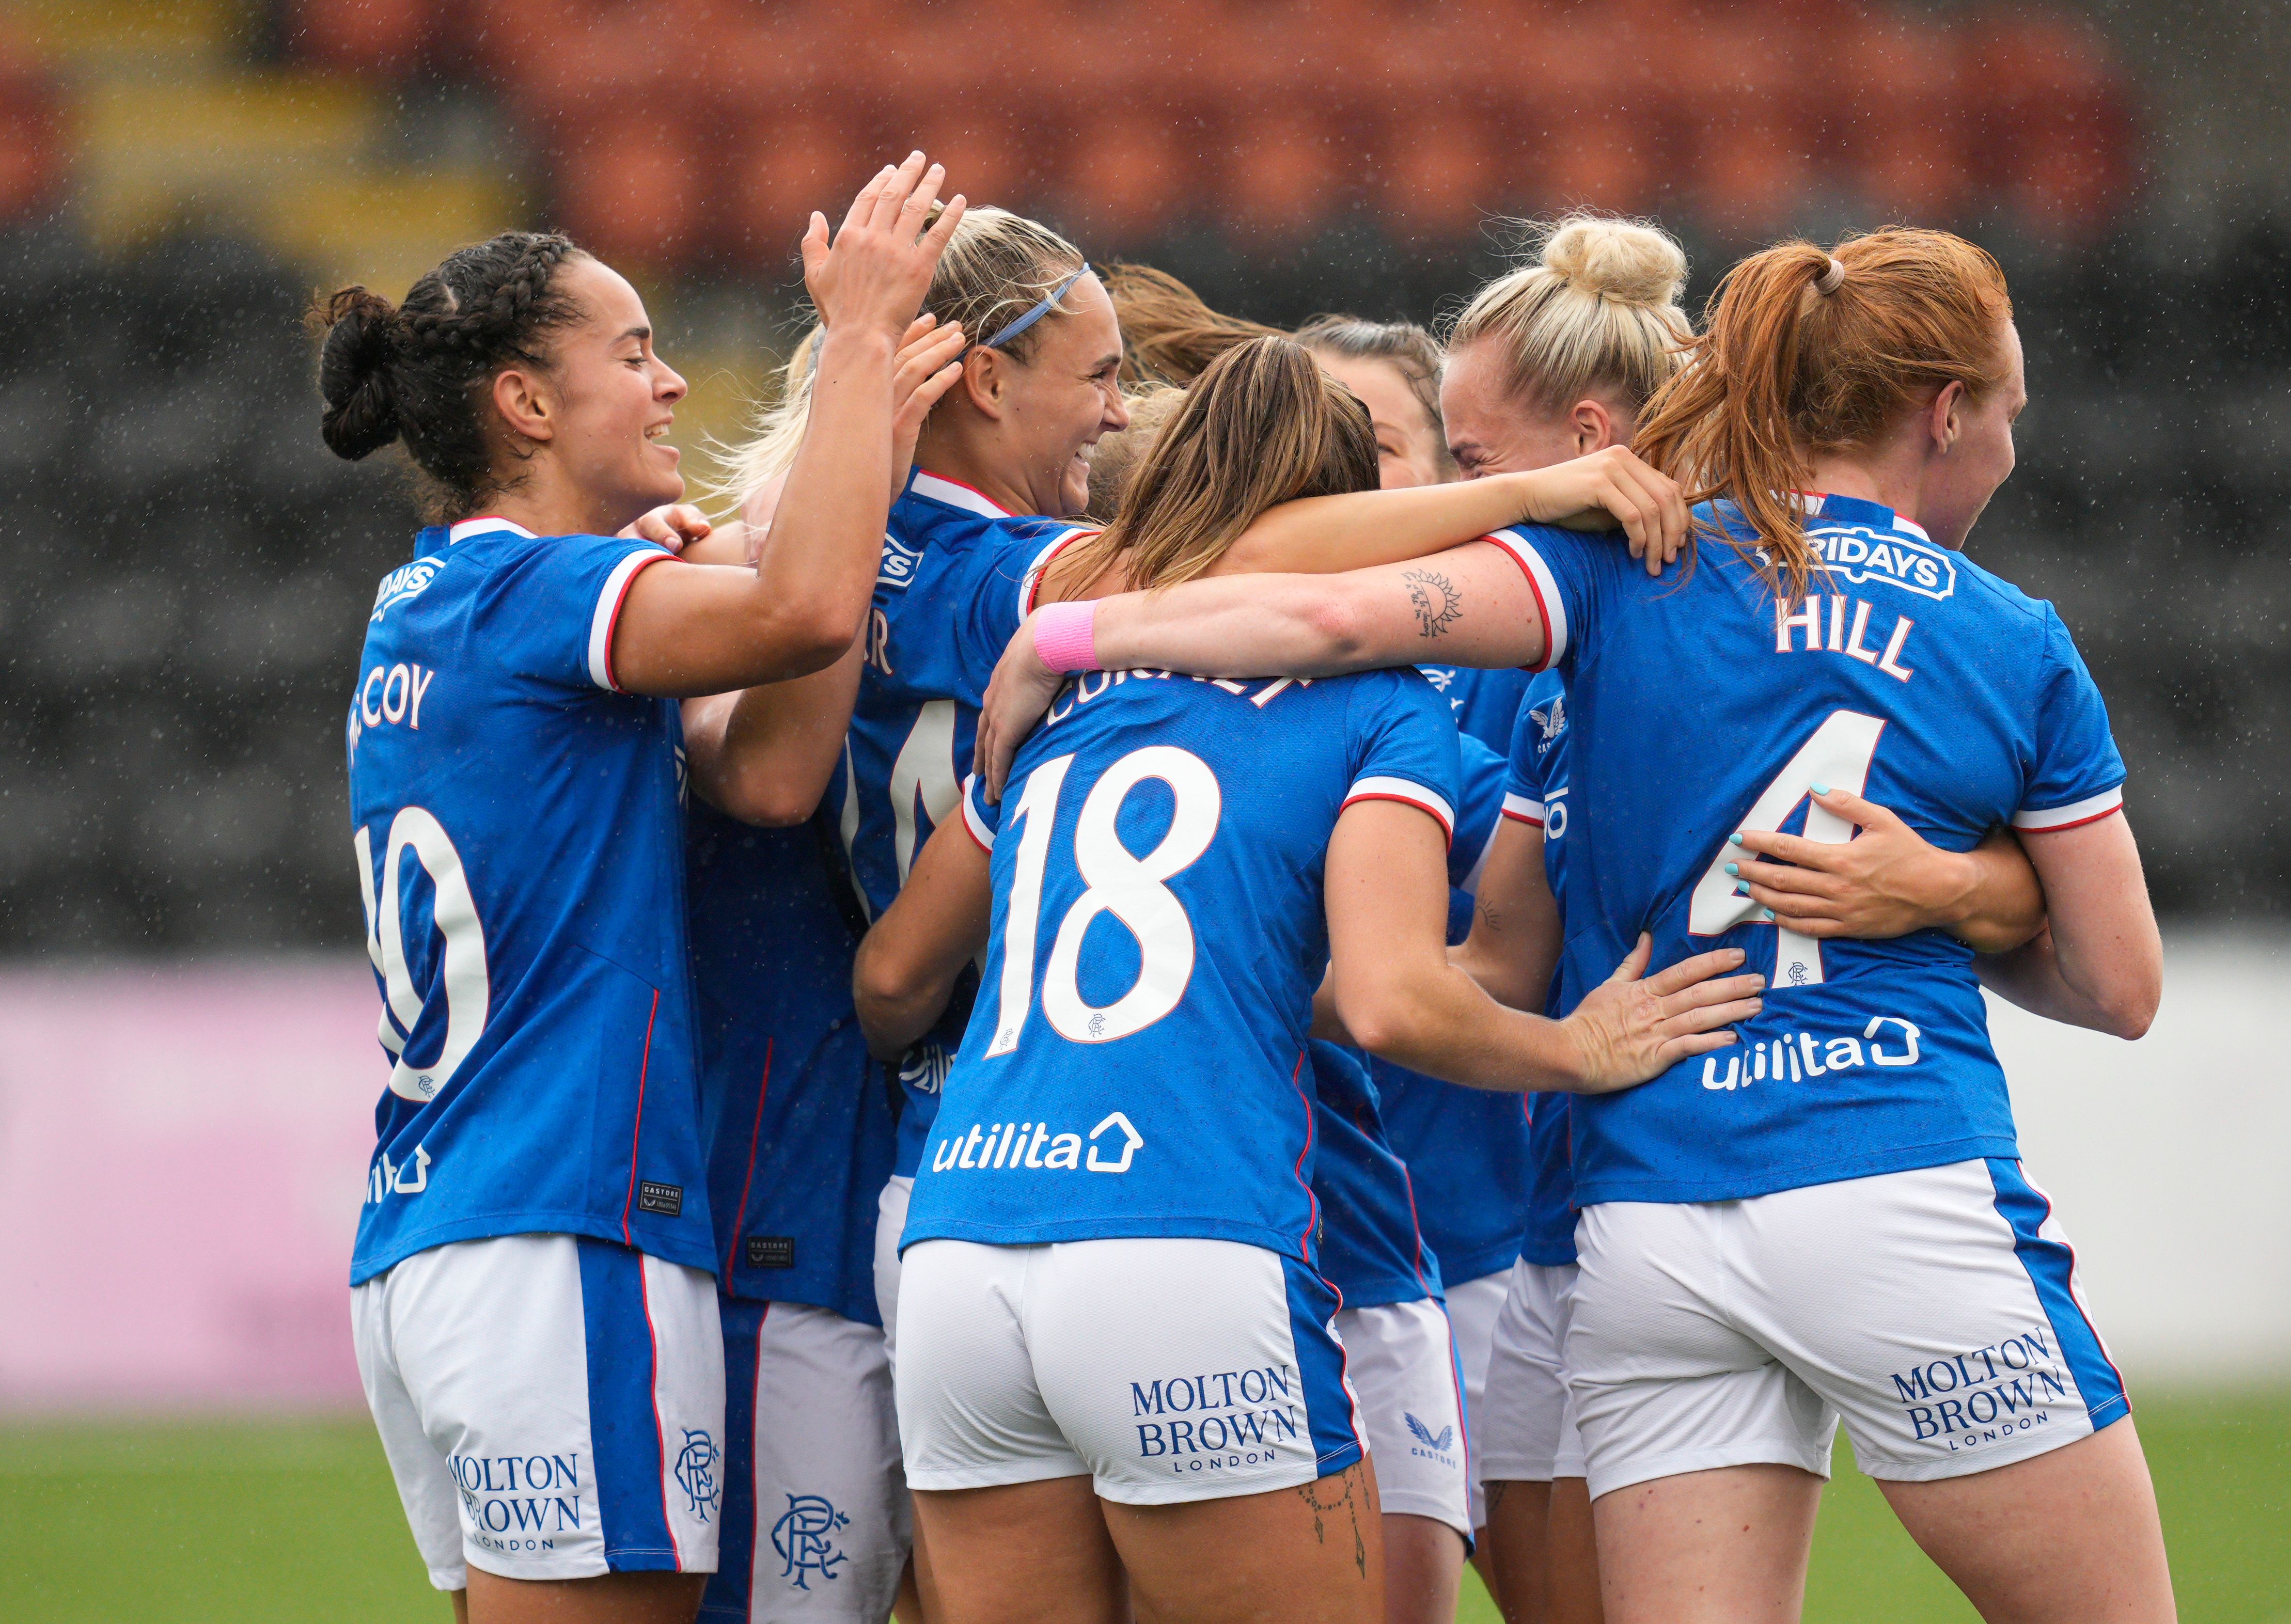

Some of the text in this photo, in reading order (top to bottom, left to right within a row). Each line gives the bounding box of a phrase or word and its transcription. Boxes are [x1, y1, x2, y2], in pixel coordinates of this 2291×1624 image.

[1801, 537, 1939, 587] RIDAYS
[1775, 594, 1914, 683] HILL
[1687, 709, 1887, 988] 4
[983, 746, 1221, 1060] 18
[932, 1122, 1082, 1173] utilita
[644, 1186, 678, 1198] CASTORE
[1890, 1326, 2050, 1404] MOLTON
[1129, 1365, 1289, 1416] MOLTON
[1906, 1365, 2066, 1441] BROWN
[1136, 1405, 1297, 1457] BROWN
[1949, 1411, 2048, 1451] LONDON
[448, 1454, 578, 1491] MOLTON
[1174, 1449, 1275, 1472] LONDON
[1411, 1447, 1456, 1470] CASTORE
[461, 1487, 581, 1532] BROWN
[474, 1533, 554, 1551] LONDON
